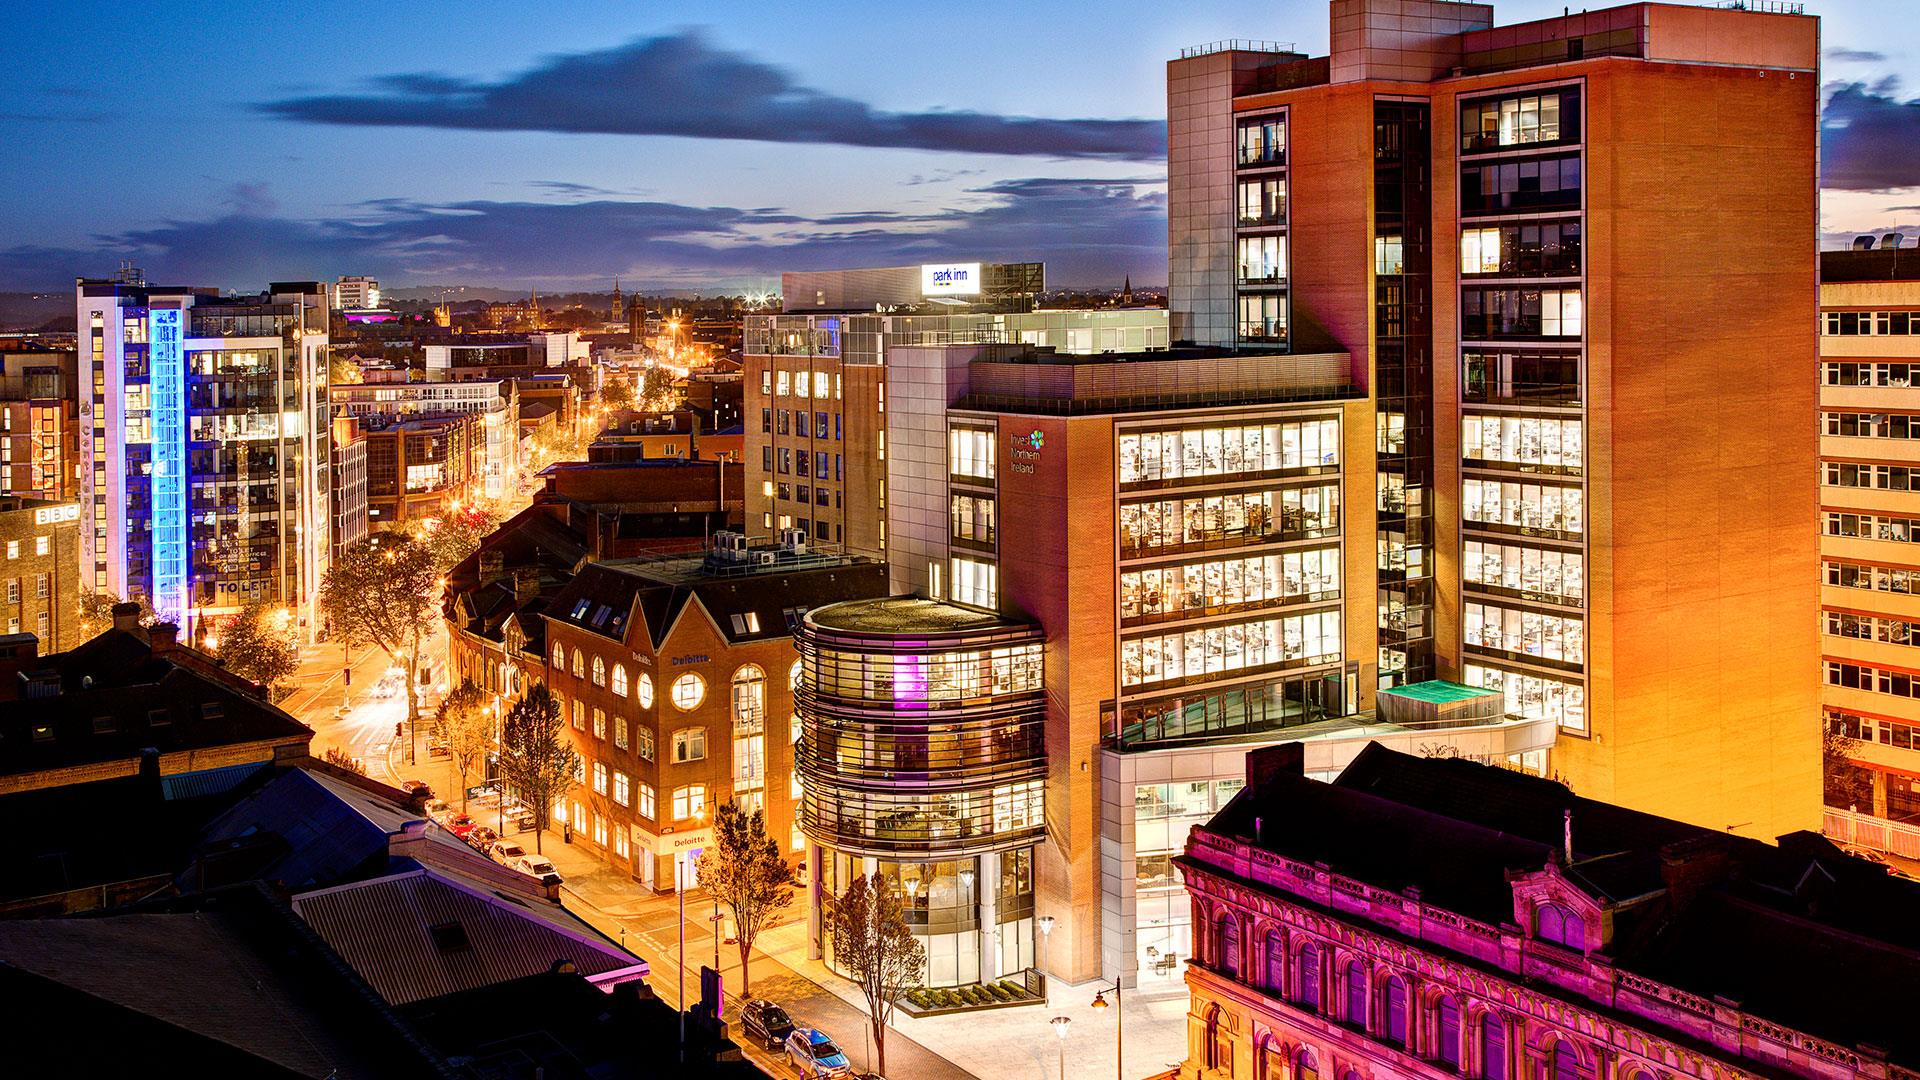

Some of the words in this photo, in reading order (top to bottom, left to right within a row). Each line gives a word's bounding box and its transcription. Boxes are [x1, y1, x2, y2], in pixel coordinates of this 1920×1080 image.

[933, 267, 953, 286] park
[954, 267, 967, 280] inn
[1010, 461, 1034, 474] Ireland
[40, 506, 75, 523] BBC
[219, 583, 238, 593] TO
[242, 580, 268, 592] LET
